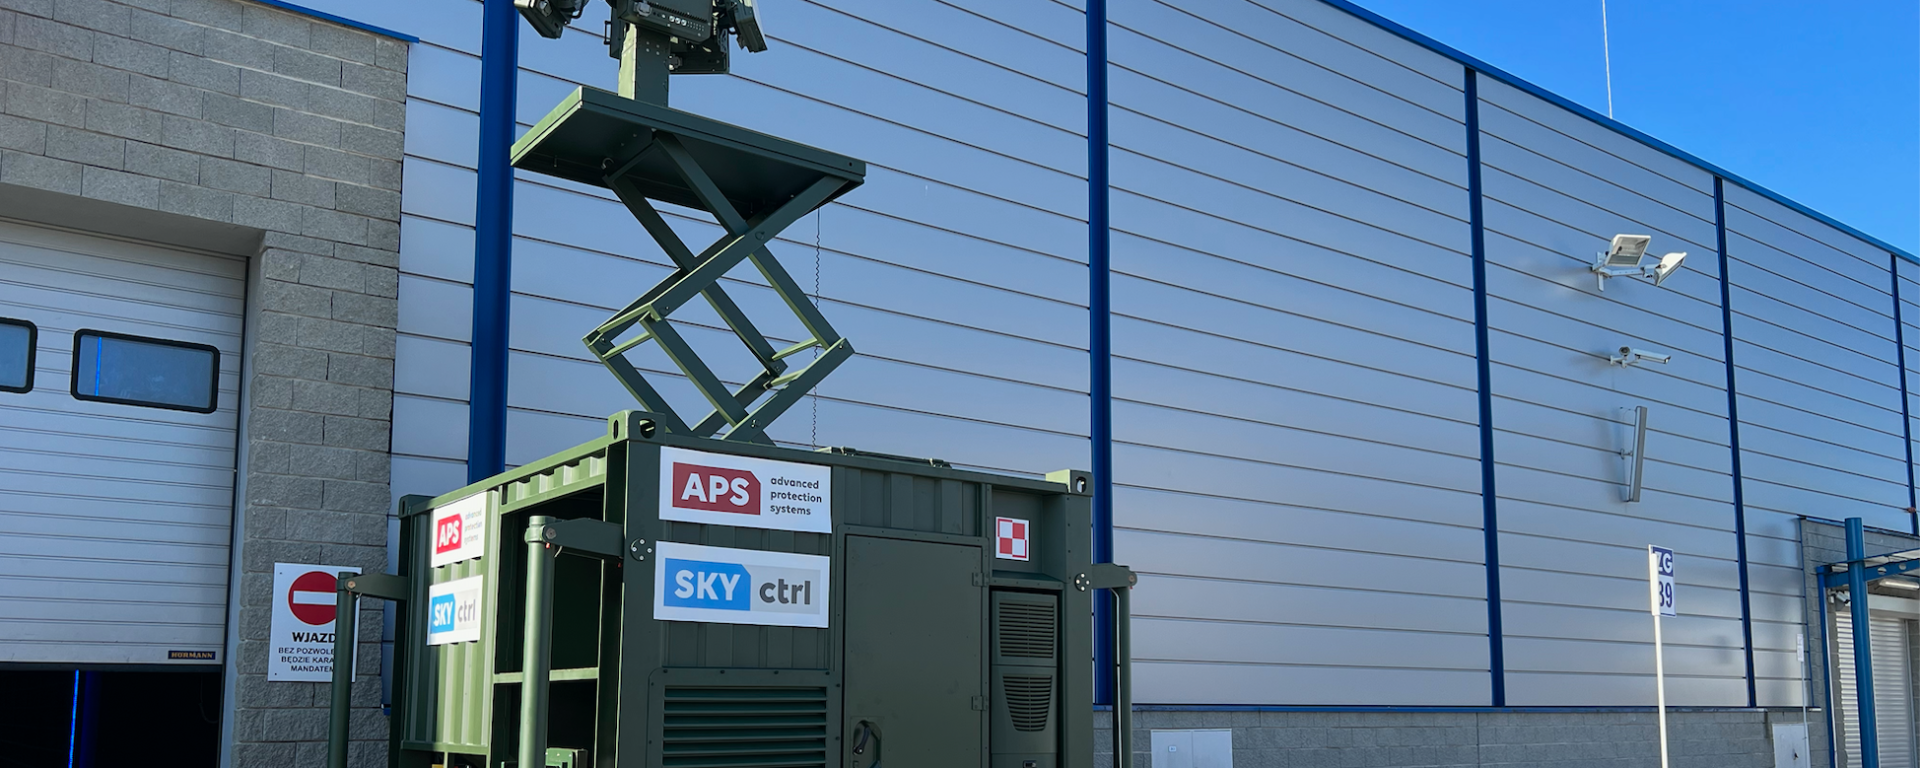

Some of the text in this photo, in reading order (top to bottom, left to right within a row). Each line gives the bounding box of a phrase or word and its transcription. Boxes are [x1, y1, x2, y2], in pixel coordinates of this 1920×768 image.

[681, 473, 750, 506] APS
[770, 476, 819, 490] advanced
[770, 491, 822, 503] protection
[770, 505, 811, 516] systems
[438, 520, 460, 548] APS
[674, 569, 811, 605] SKY ctrl
[433, 598, 476, 627] SKY ctrl
[292, 631, 336, 643] WJAZD
[296, 647, 334, 655] POZWOLE
